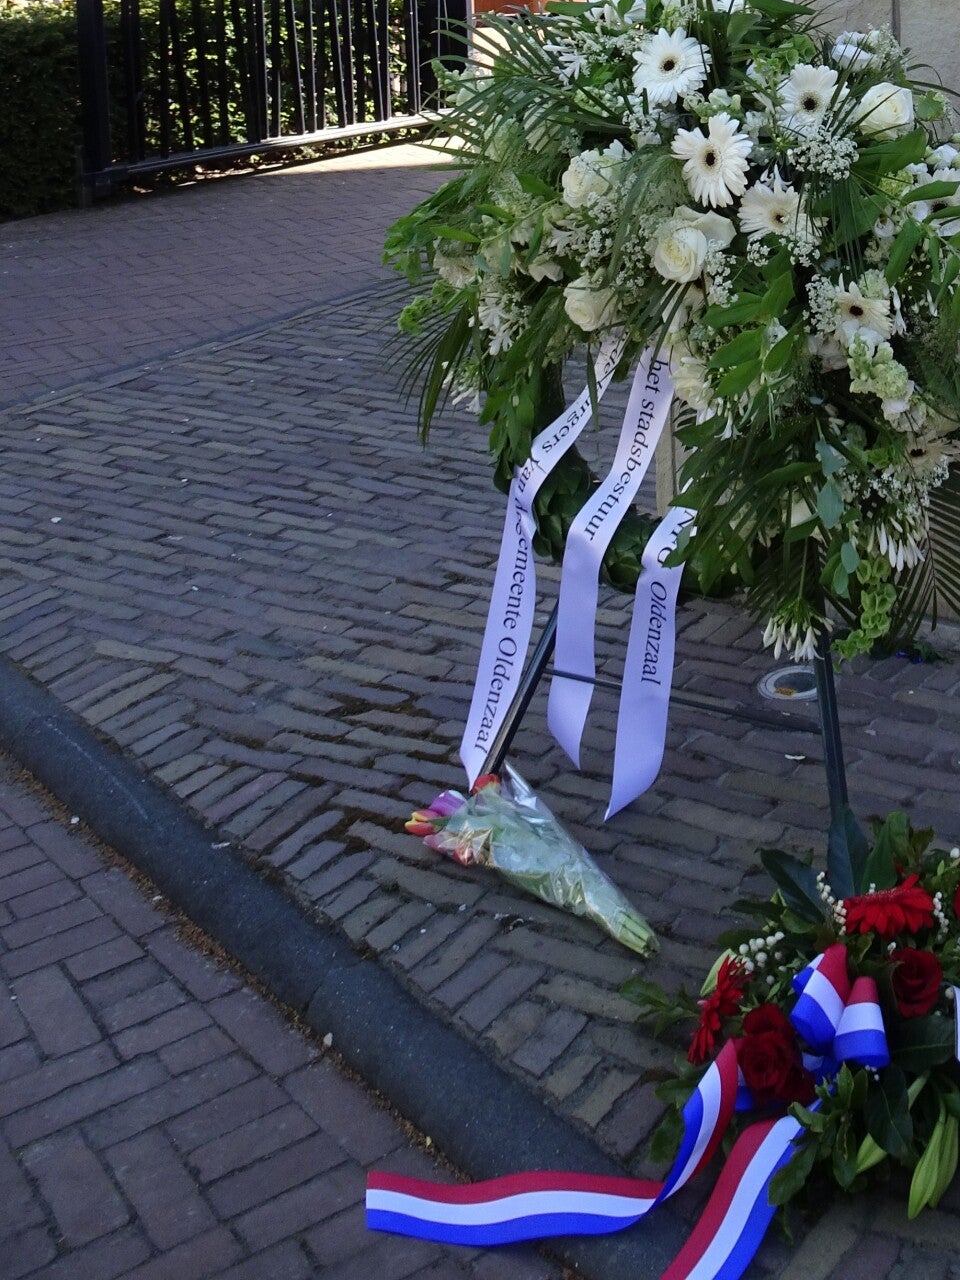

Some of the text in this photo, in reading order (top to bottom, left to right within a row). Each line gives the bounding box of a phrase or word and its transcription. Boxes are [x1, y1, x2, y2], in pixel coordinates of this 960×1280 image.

[584, 357, 669, 542] het stadsbestuur
[640, 580, 668, 686] Oldenzaal
[474, 636, 518, 754] Oldenzaal
